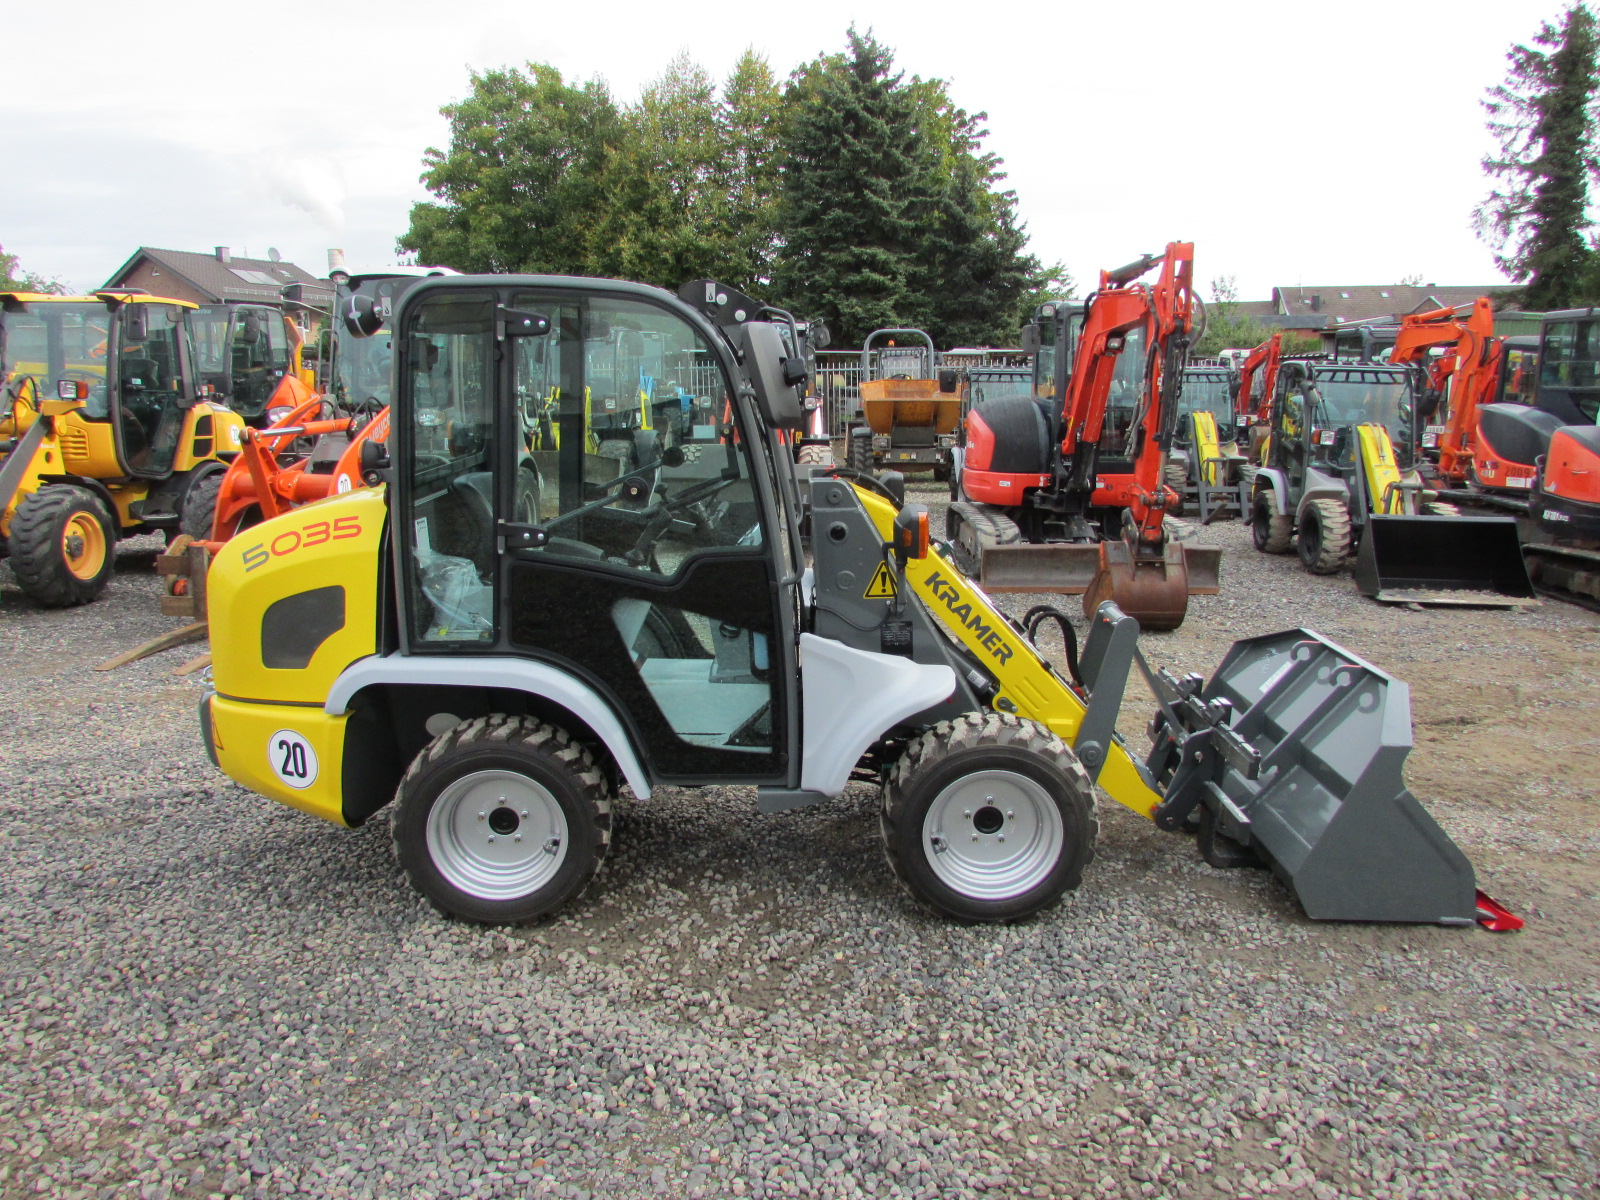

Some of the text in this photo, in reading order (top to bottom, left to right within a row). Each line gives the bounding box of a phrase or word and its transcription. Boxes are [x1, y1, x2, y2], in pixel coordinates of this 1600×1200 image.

[1505, 466, 1531, 477] 2009
[242, 515, 363, 573] 5035
[923, 570, 1014, 668] KRAMER
[278, 739, 308, 779] 20
